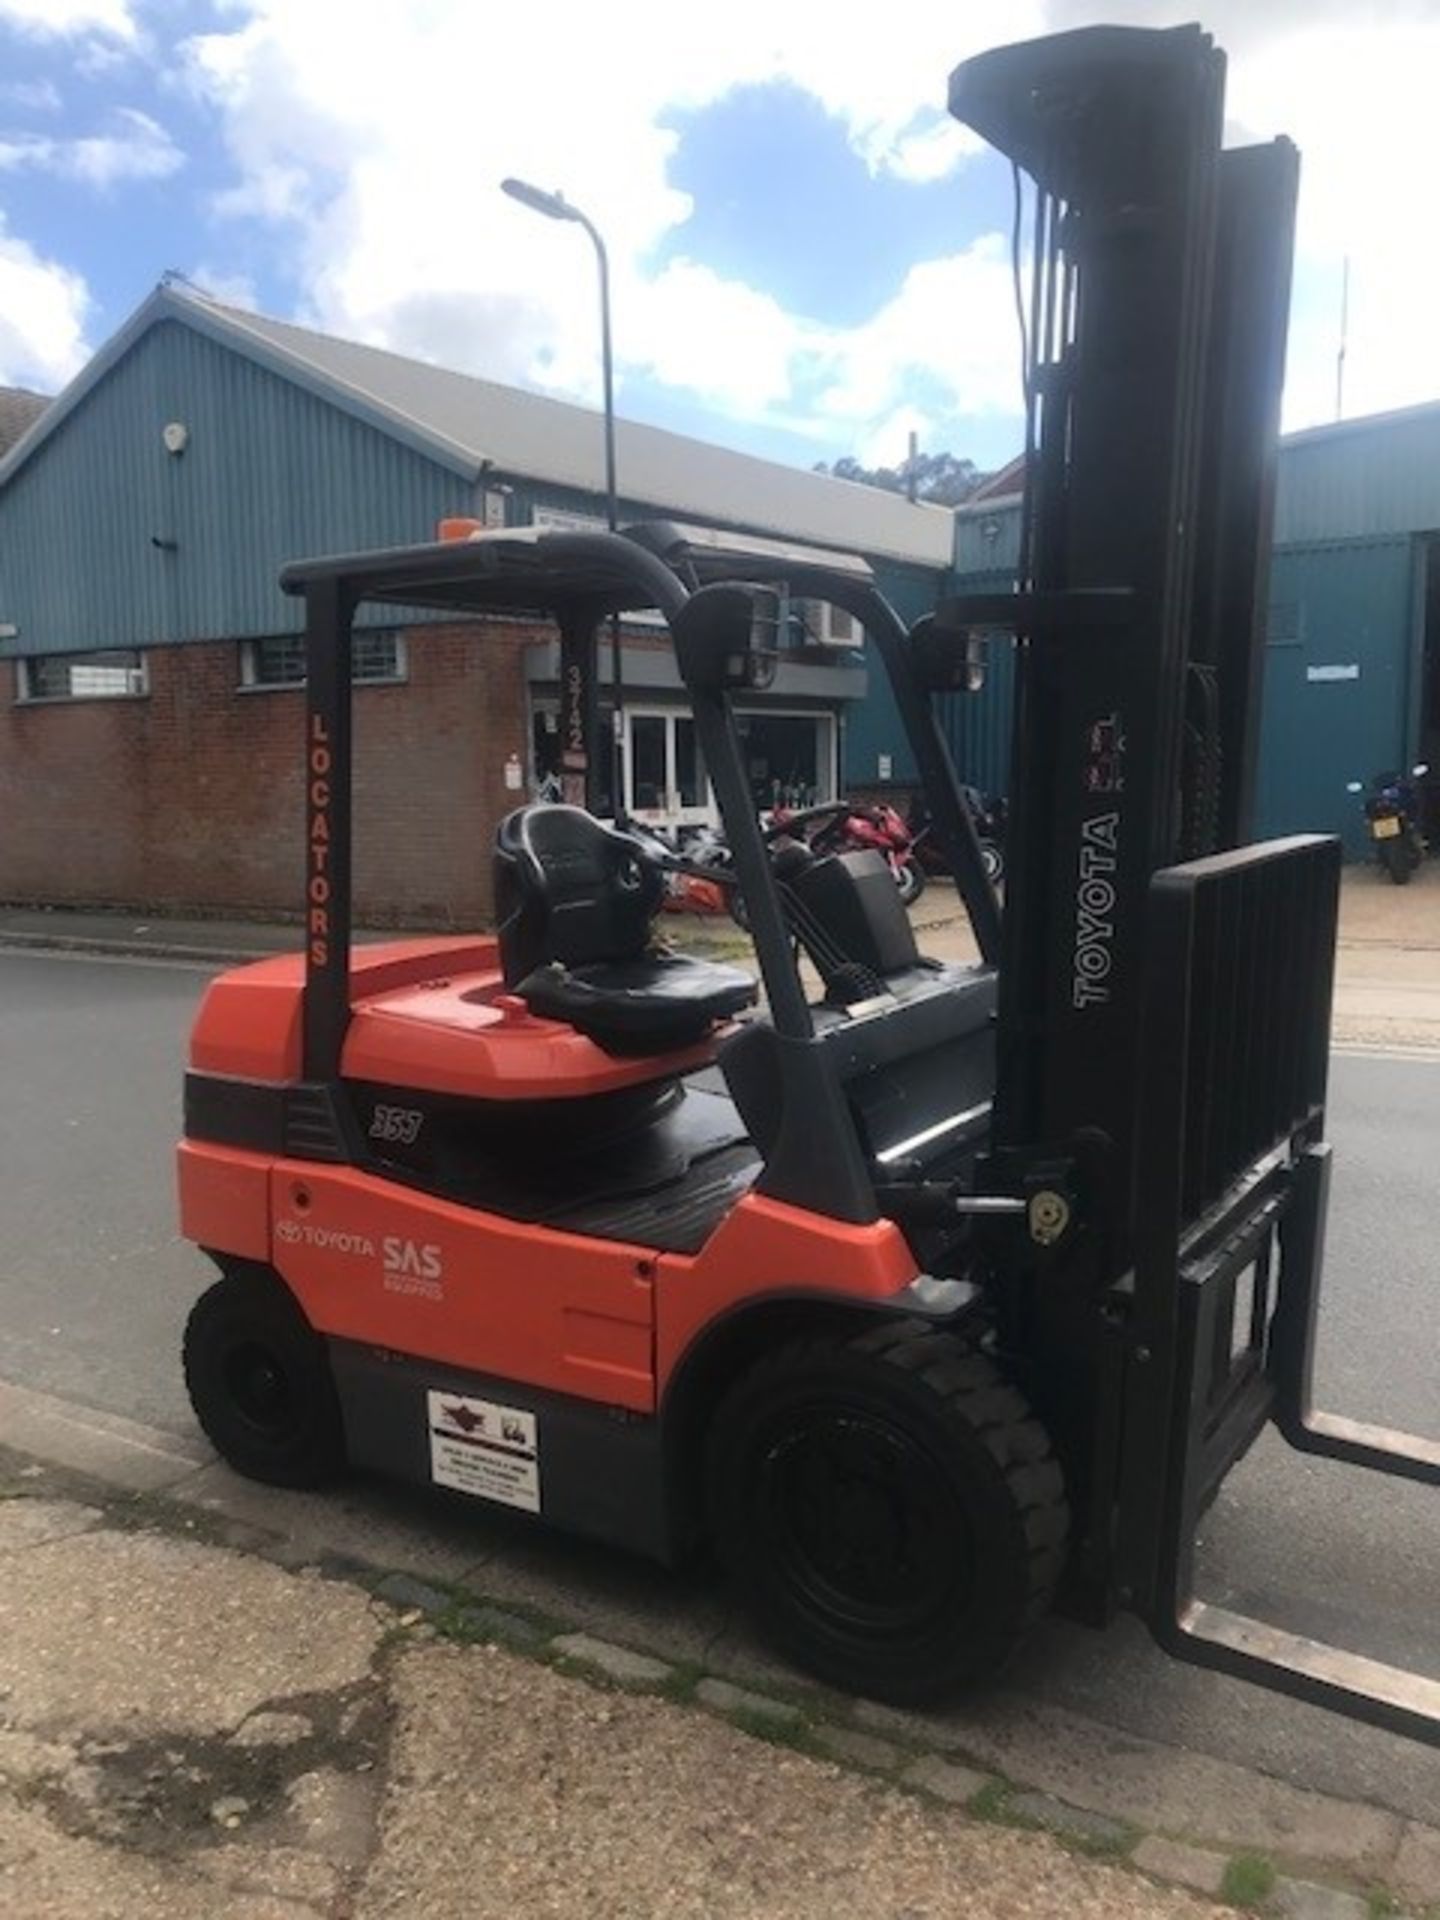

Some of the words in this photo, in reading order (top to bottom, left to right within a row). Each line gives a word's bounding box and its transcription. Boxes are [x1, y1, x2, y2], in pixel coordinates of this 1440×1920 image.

[310, 715, 331, 966] LOCATORS
[1073, 812, 1120, 1009] TOYOTA
[303, 1227, 375, 1257] TOYOTA
[383, 1237, 442, 1279] SAS
